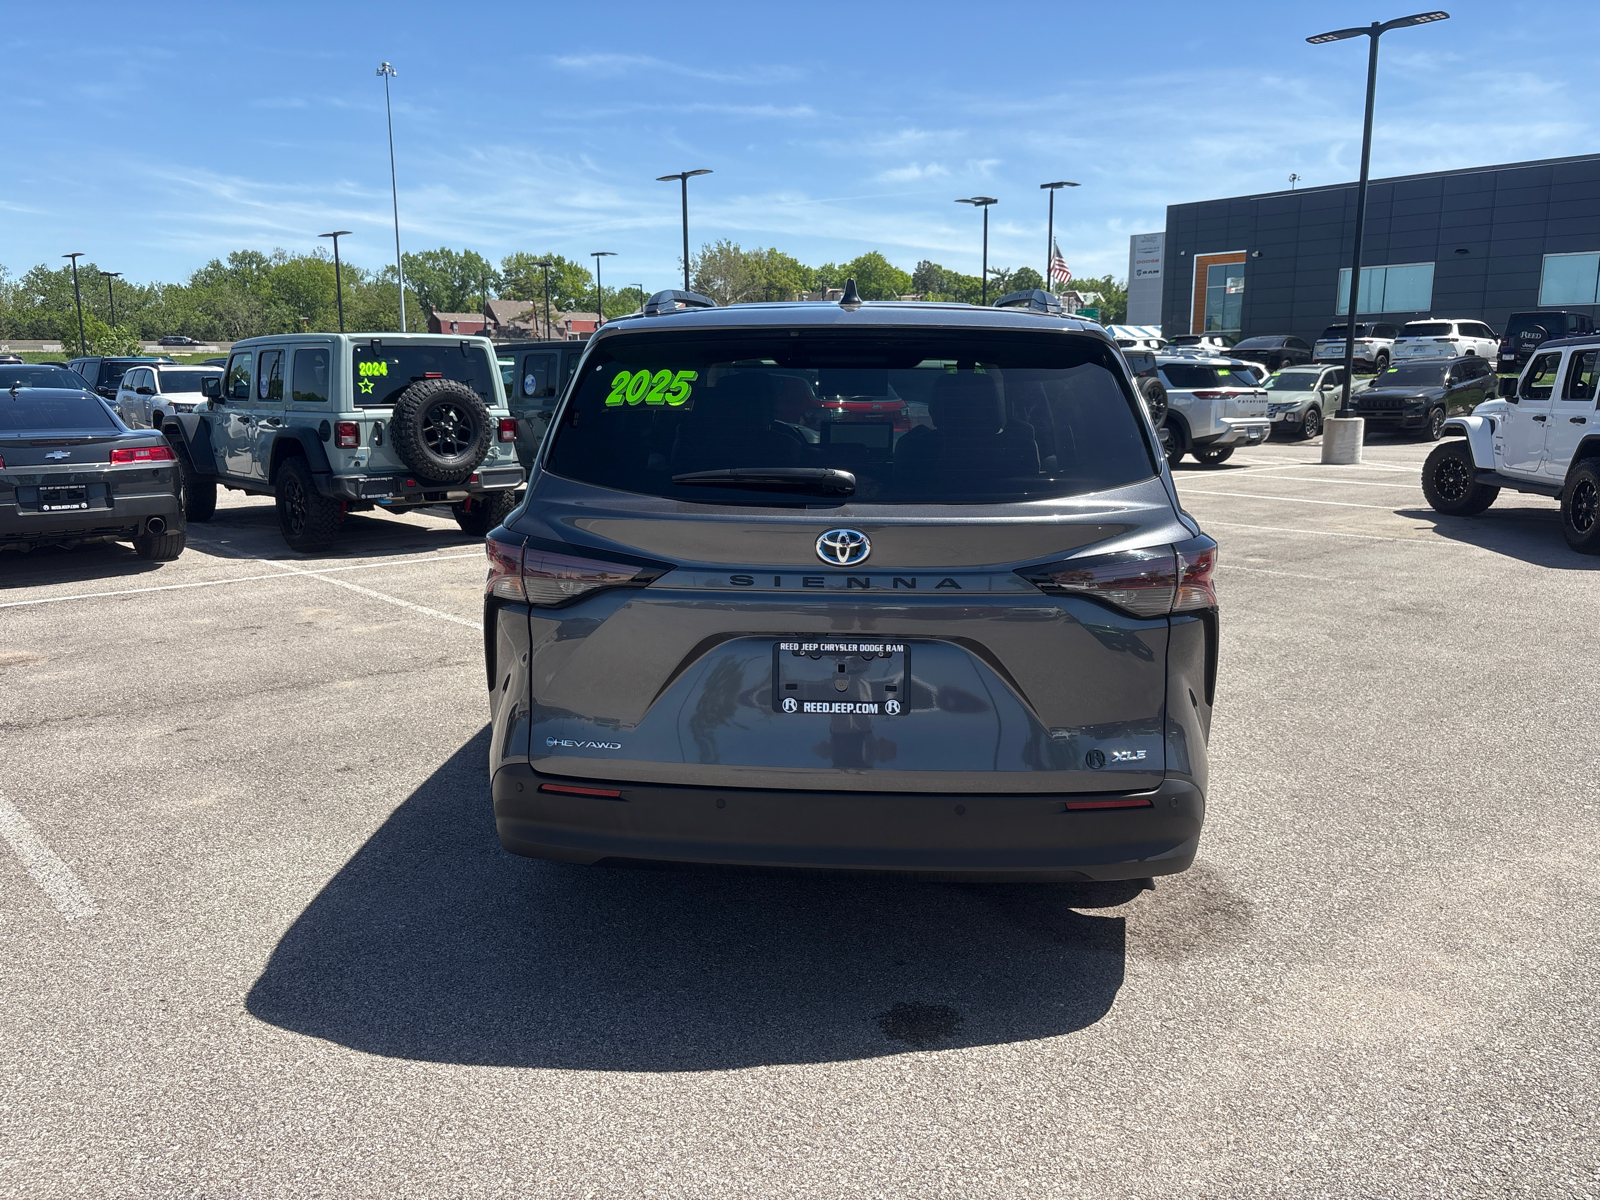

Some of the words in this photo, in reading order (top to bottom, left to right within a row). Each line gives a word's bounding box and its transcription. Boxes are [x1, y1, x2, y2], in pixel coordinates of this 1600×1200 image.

[359, 361, 388, 376] 2024
[605, 369, 699, 407] 2025
[729, 574, 963, 590] SIENNA
[780, 642, 799, 651] REED
[800, 643, 819, 651] JEEP
[820, 643, 858, 652] CHRYSLER
[860, 644, 884, 652] DODGE
[886, 645, 904, 653] RAM
[803, 702, 879, 714] REEDJEEP.COM
[1112, 750, 1147, 762] XLE
